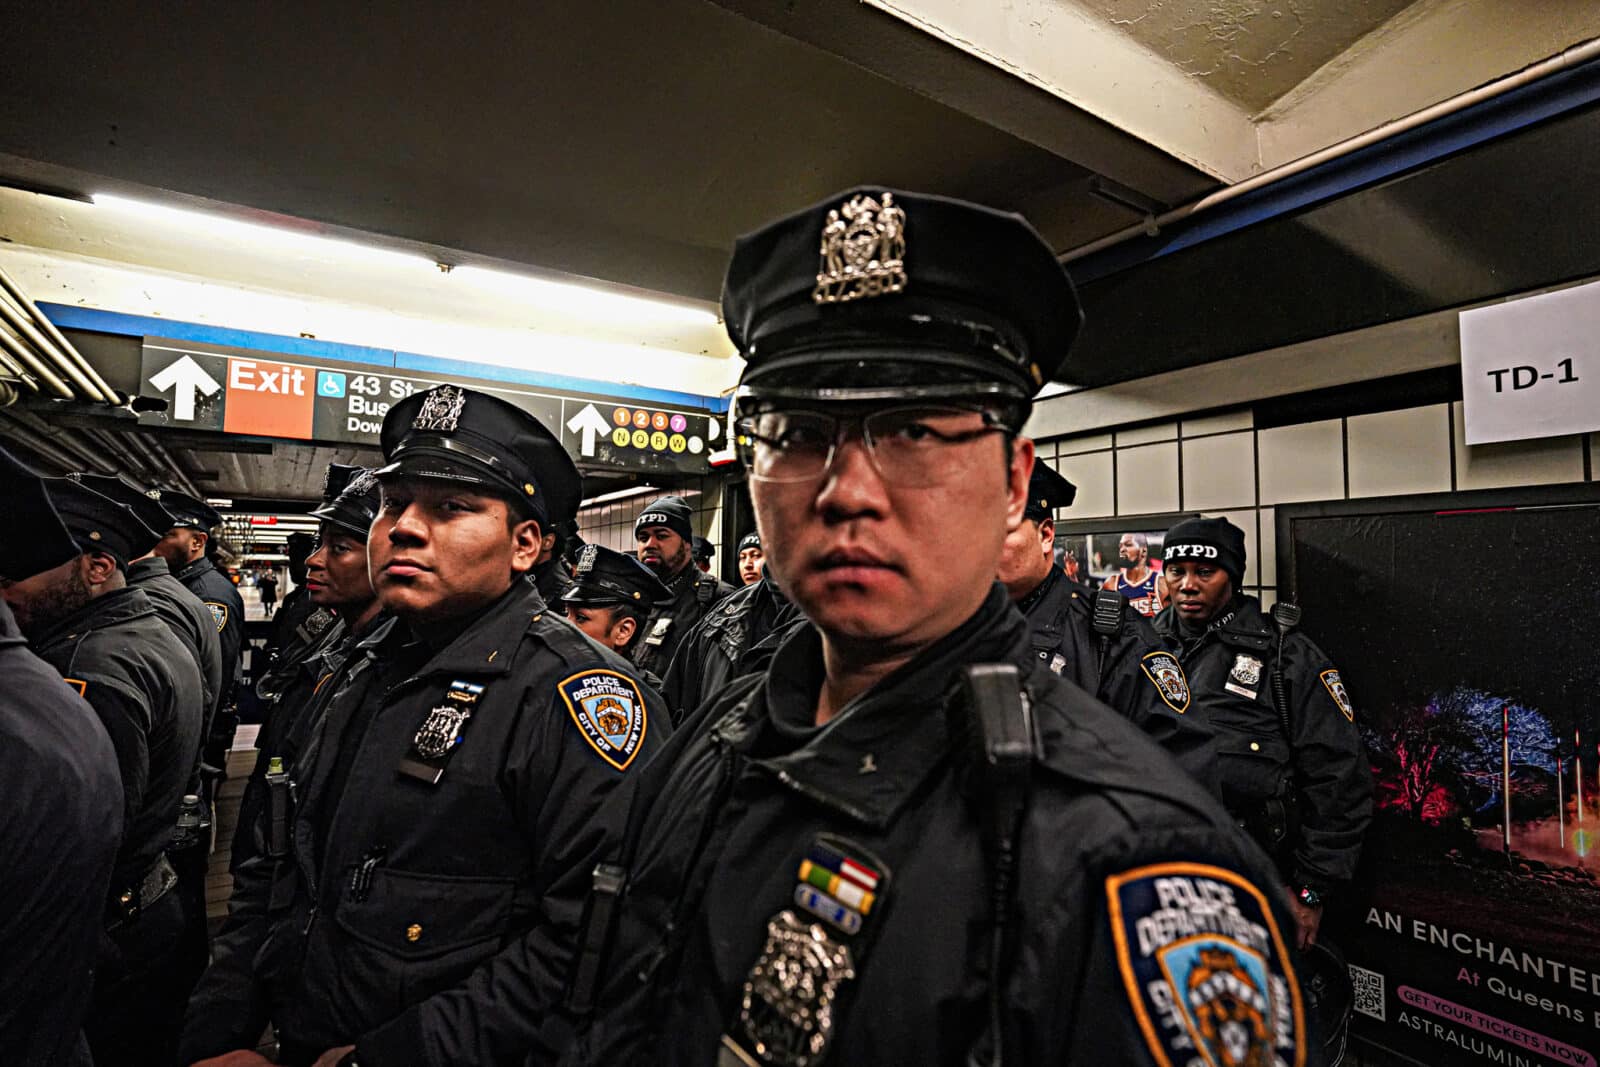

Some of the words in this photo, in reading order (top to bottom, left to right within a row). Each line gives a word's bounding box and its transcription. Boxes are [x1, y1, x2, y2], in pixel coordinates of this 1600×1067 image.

[230, 360, 305, 396] Exit
[350, 375, 381, 396] 43
[1487, 357, 1579, 393] TD-1
[348, 394, 391, 417] Bus
[1165, 544, 1218, 560] NYPD
[572, 685, 634, 701] DEPARTMENT
[582, 676, 620, 688] POLICE
[578, 712, 598, 737] CITY
[596, 737, 611, 751] OF
[624, 731, 639, 754] NEW
[633, 704, 642, 731] YORK
[1365, 907, 1402, 934] AN
[1456, 967, 1480, 987] At
[1487, 976, 1585, 1023] Queens
[1398, 1011, 1543, 1067] ASTRALUMIN
[1403, 990, 1430, 1005] GET
[1433, 1001, 1474, 1023] YOUR
[1477, 1016, 1540, 1048] TICKETS
[1544, 1041, 1589, 1066] NOW
